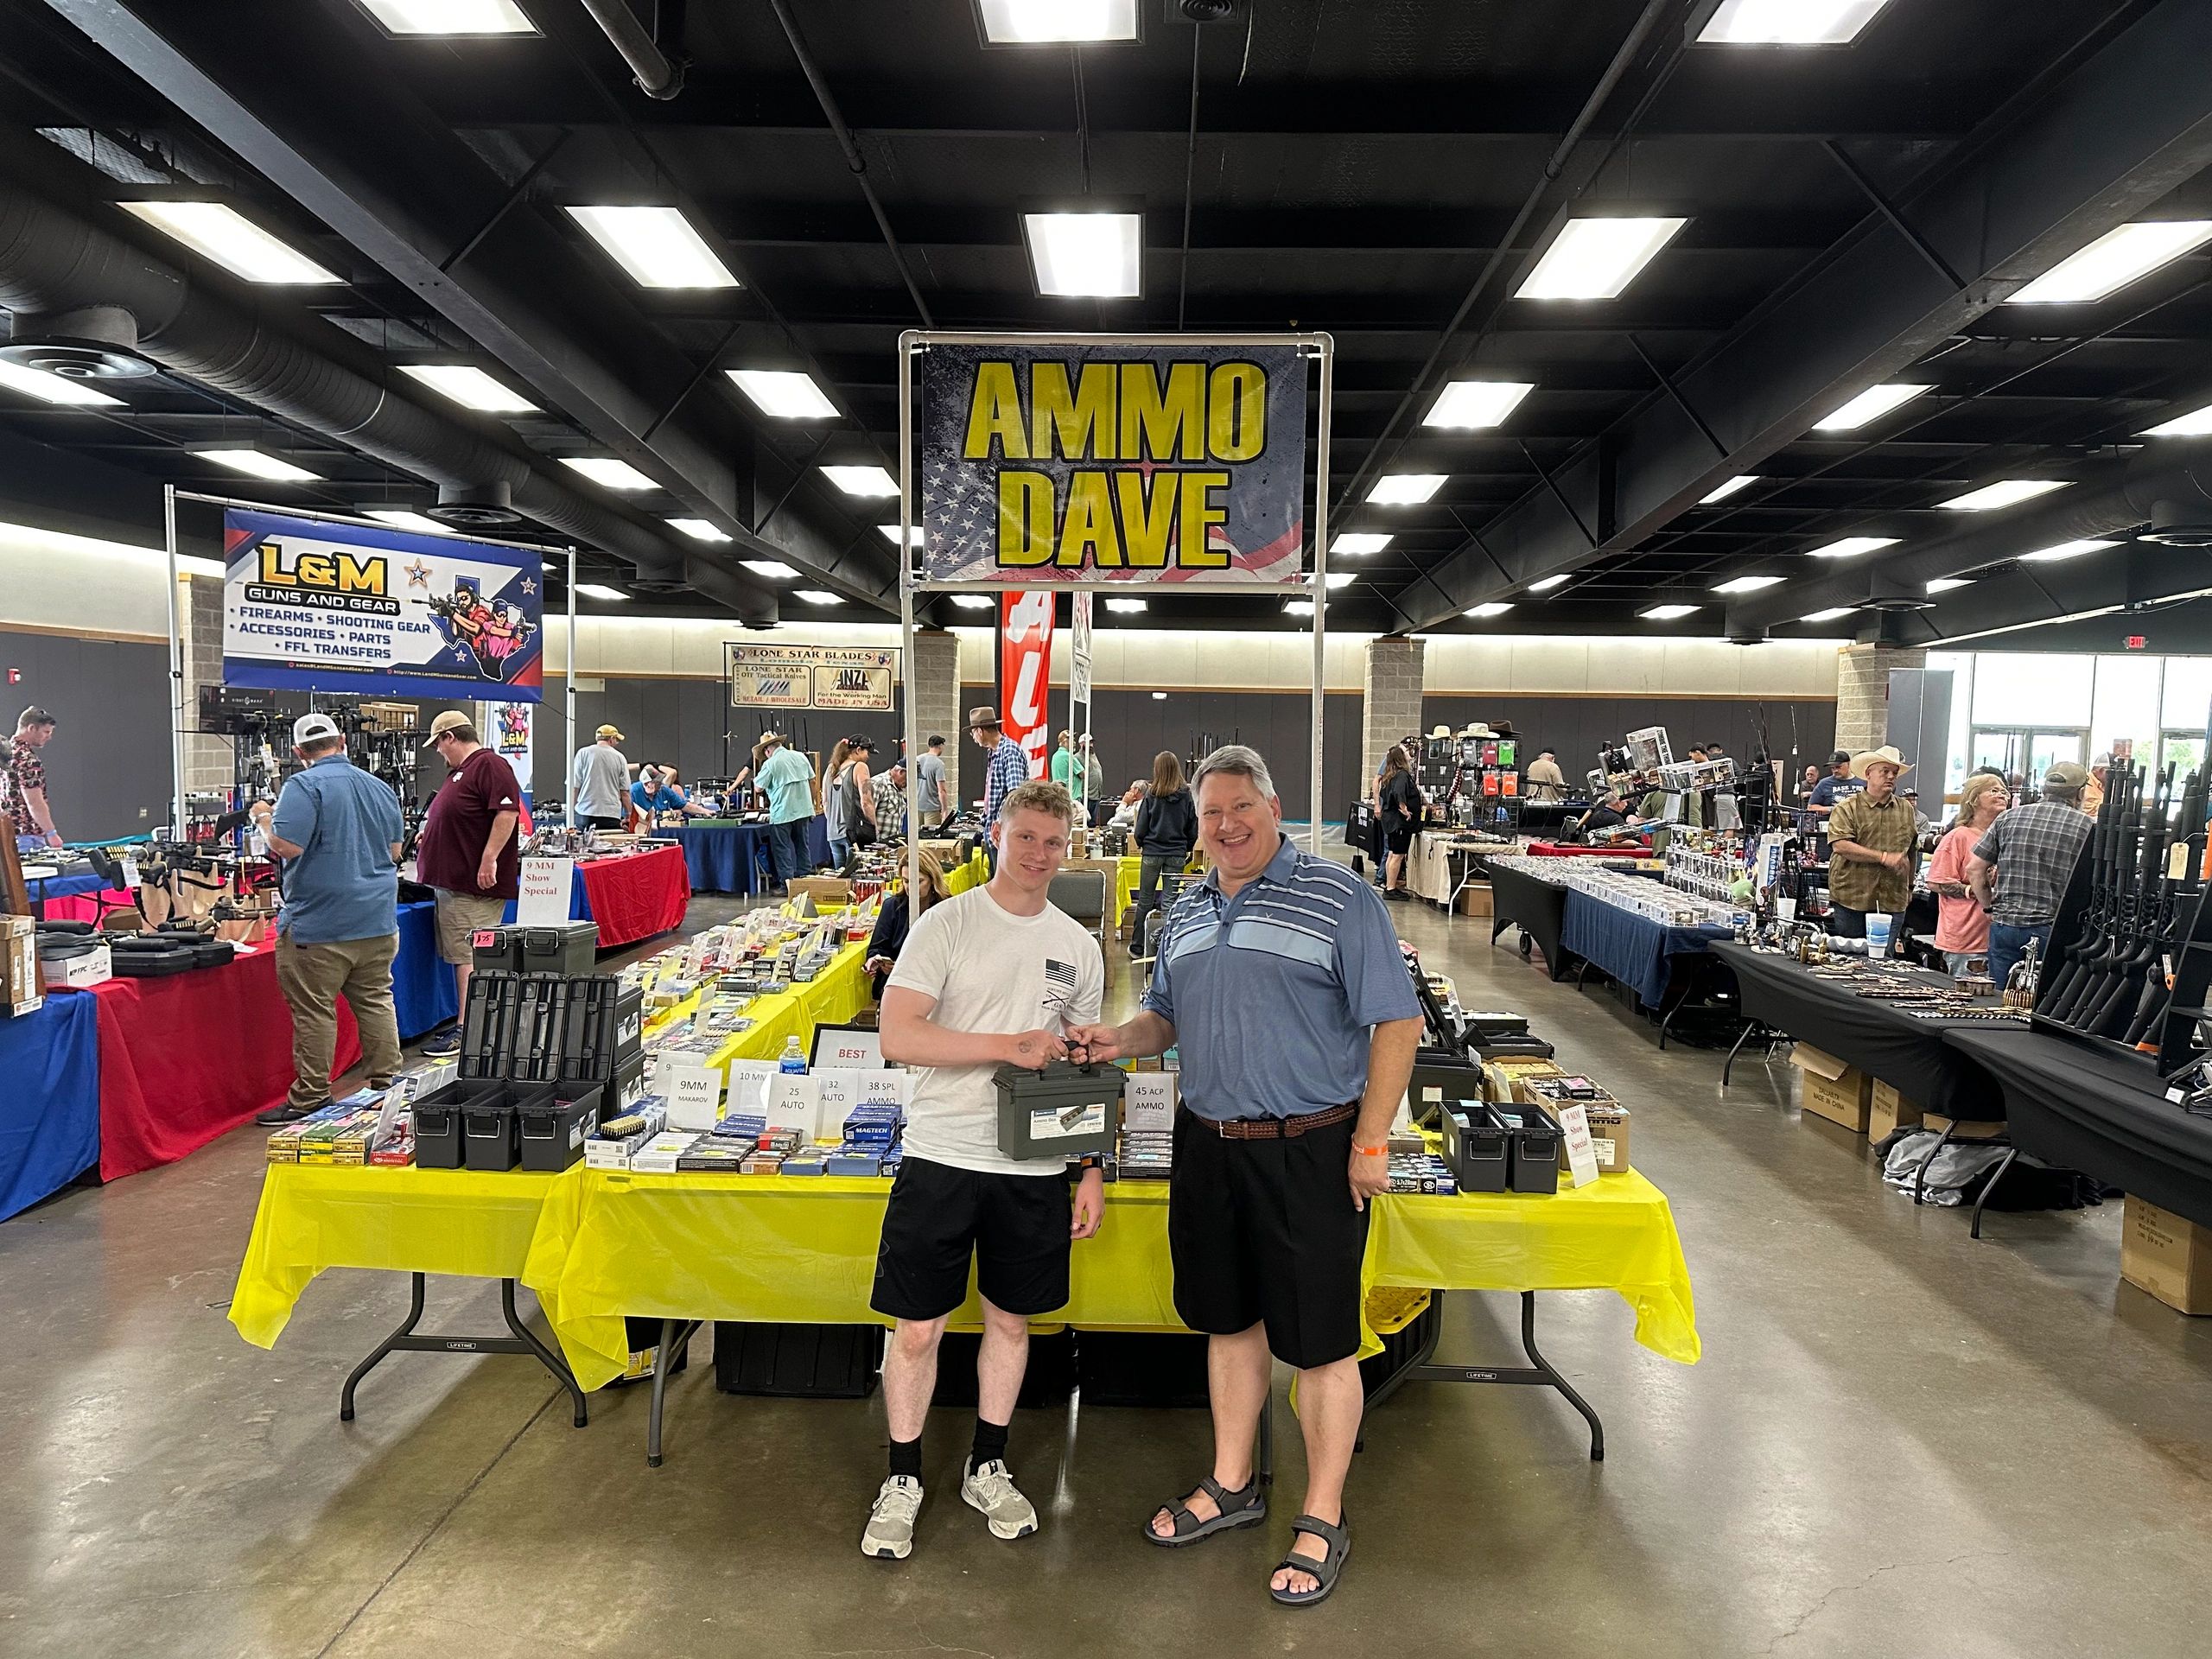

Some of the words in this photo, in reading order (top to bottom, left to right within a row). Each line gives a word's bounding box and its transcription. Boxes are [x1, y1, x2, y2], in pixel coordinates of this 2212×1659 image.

[963, 360, 1268, 462] AMMO
[997, 469, 1230, 569] DAVE
[259, 543, 385, 595] L&M
[248, 588, 302, 604] GUNS
[306, 594, 345, 608] AND
[349, 598, 397, 613] GEAR
[239, 607, 313, 623] FIREARMS
[327, 614, 394, 632] SHOOTING
[397, 622, 431, 634] GEAR
[239, 623, 335, 640] ACCESSORIES
[349, 632, 391, 645] PARTS
[284, 641, 310, 653] FFL
[314, 644, 391, 659] TRANSFERS
[825, 652, 872, 660] BLADES
[502, 731, 525, 747] L&M
[534, 861, 555, 870] MM
[525, 874, 550, 882] Show
[524, 887, 557, 896] Special
[838, 1049, 867, 1059] BEST
[680, 1080, 707, 1091] 9MM
[868, 1082, 880, 1090] 38
[1135, 1087, 1147, 1096] 45
[780, 1101, 804, 1109] AUTO
[1135, 1102, 1165, 1110] AMMO
[1566, 1113, 1570, 1122] 9
[1569, 1126, 1583, 1135] Show
[1571, 1137, 1588, 1152] Special
